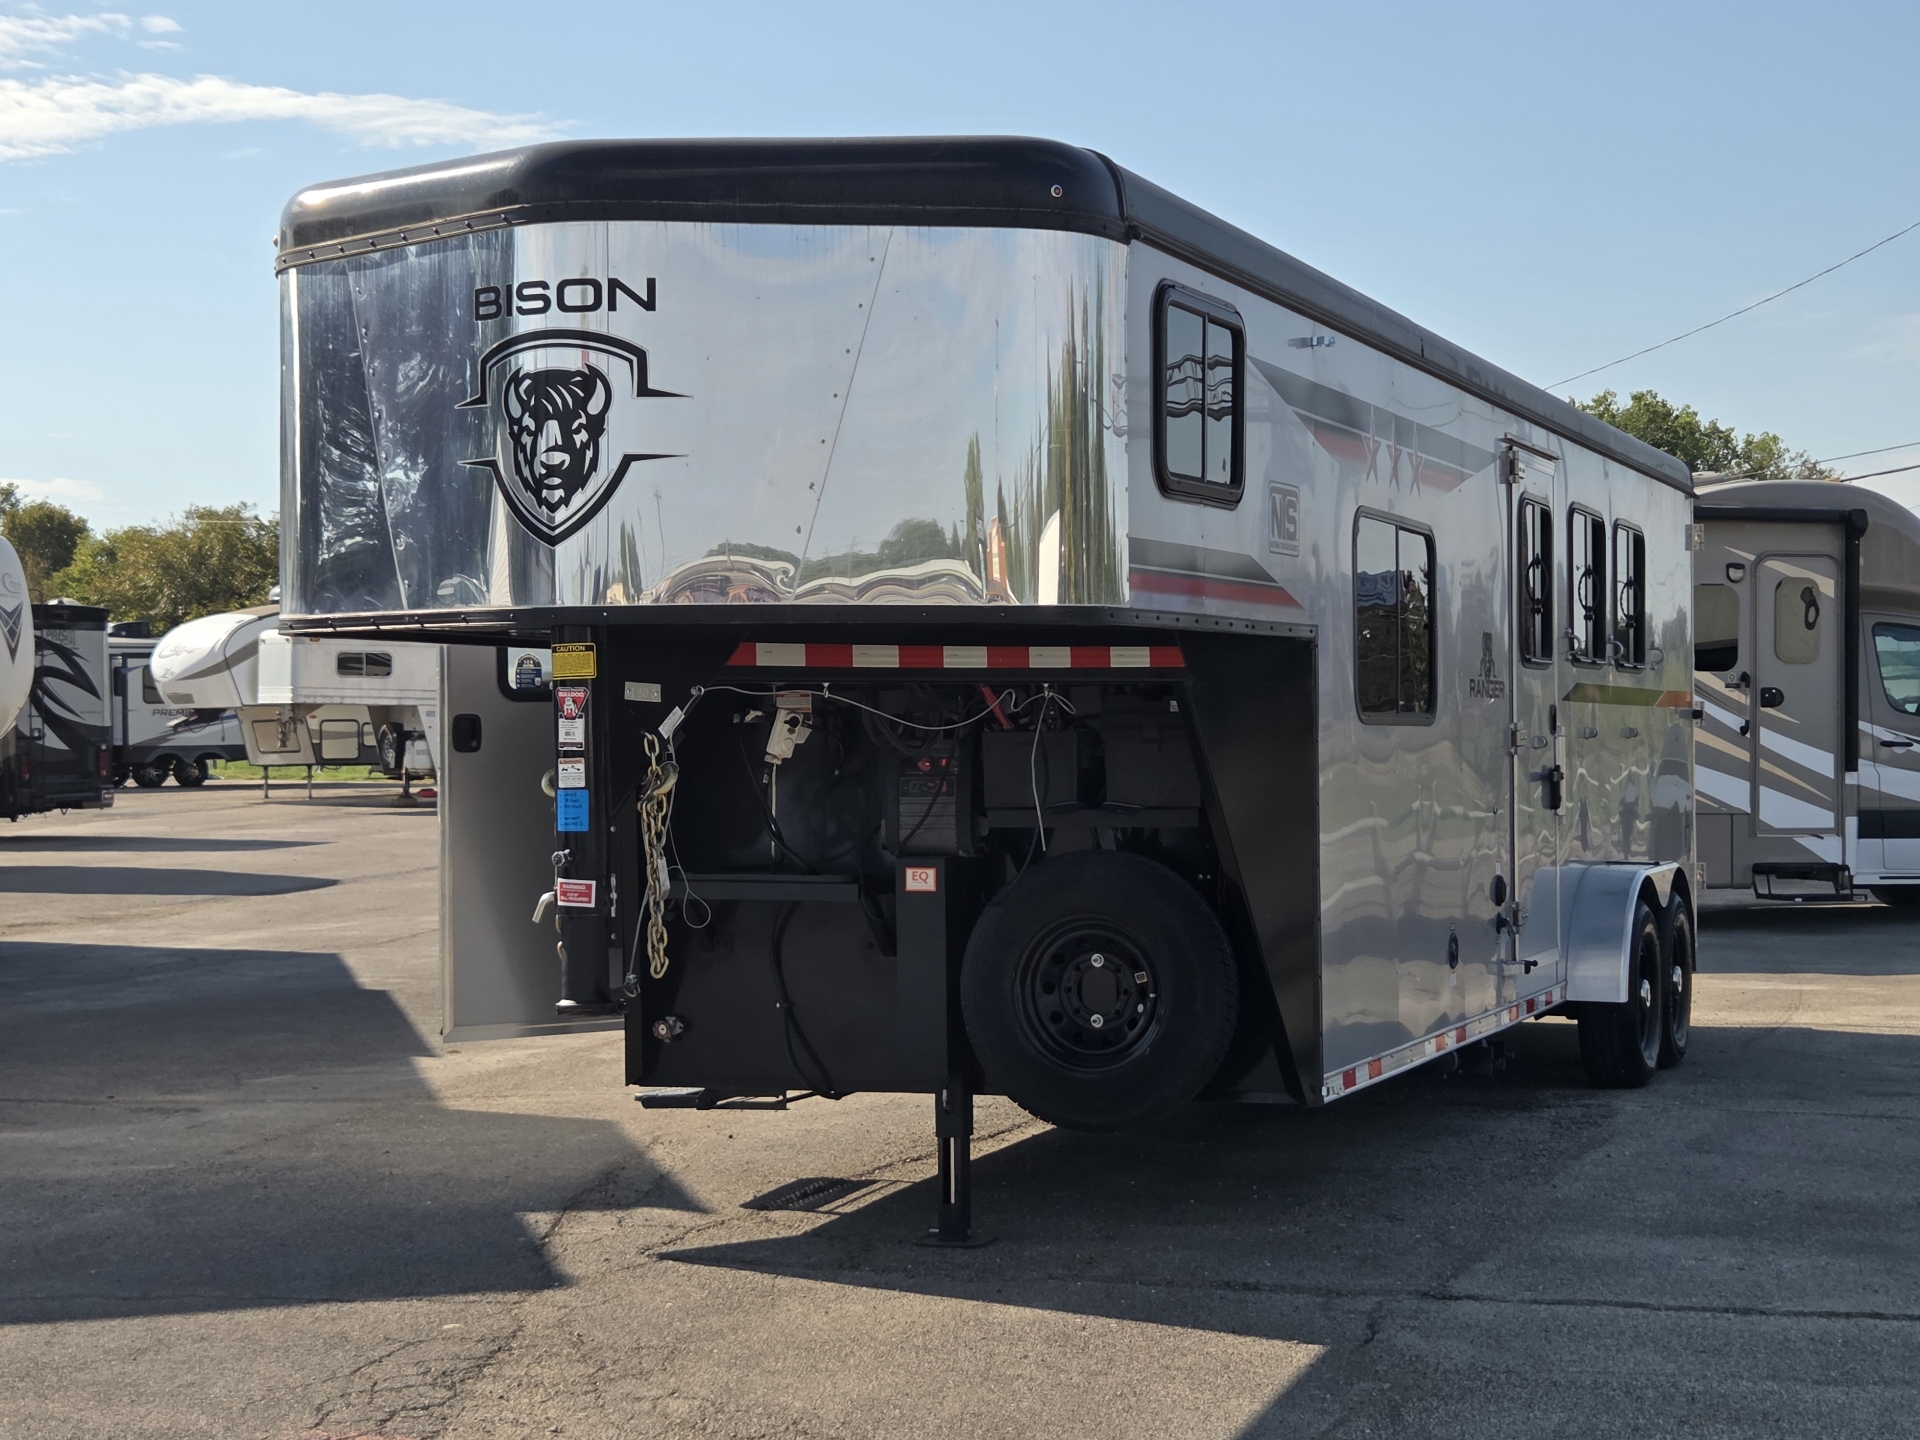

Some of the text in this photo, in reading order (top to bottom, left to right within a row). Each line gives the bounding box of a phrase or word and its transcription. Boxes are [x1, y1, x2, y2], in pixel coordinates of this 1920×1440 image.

[474, 277, 656, 322] BISON
[1469, 678, 1505, 699] RANGER
[911, 871, 929, 884] EQ
